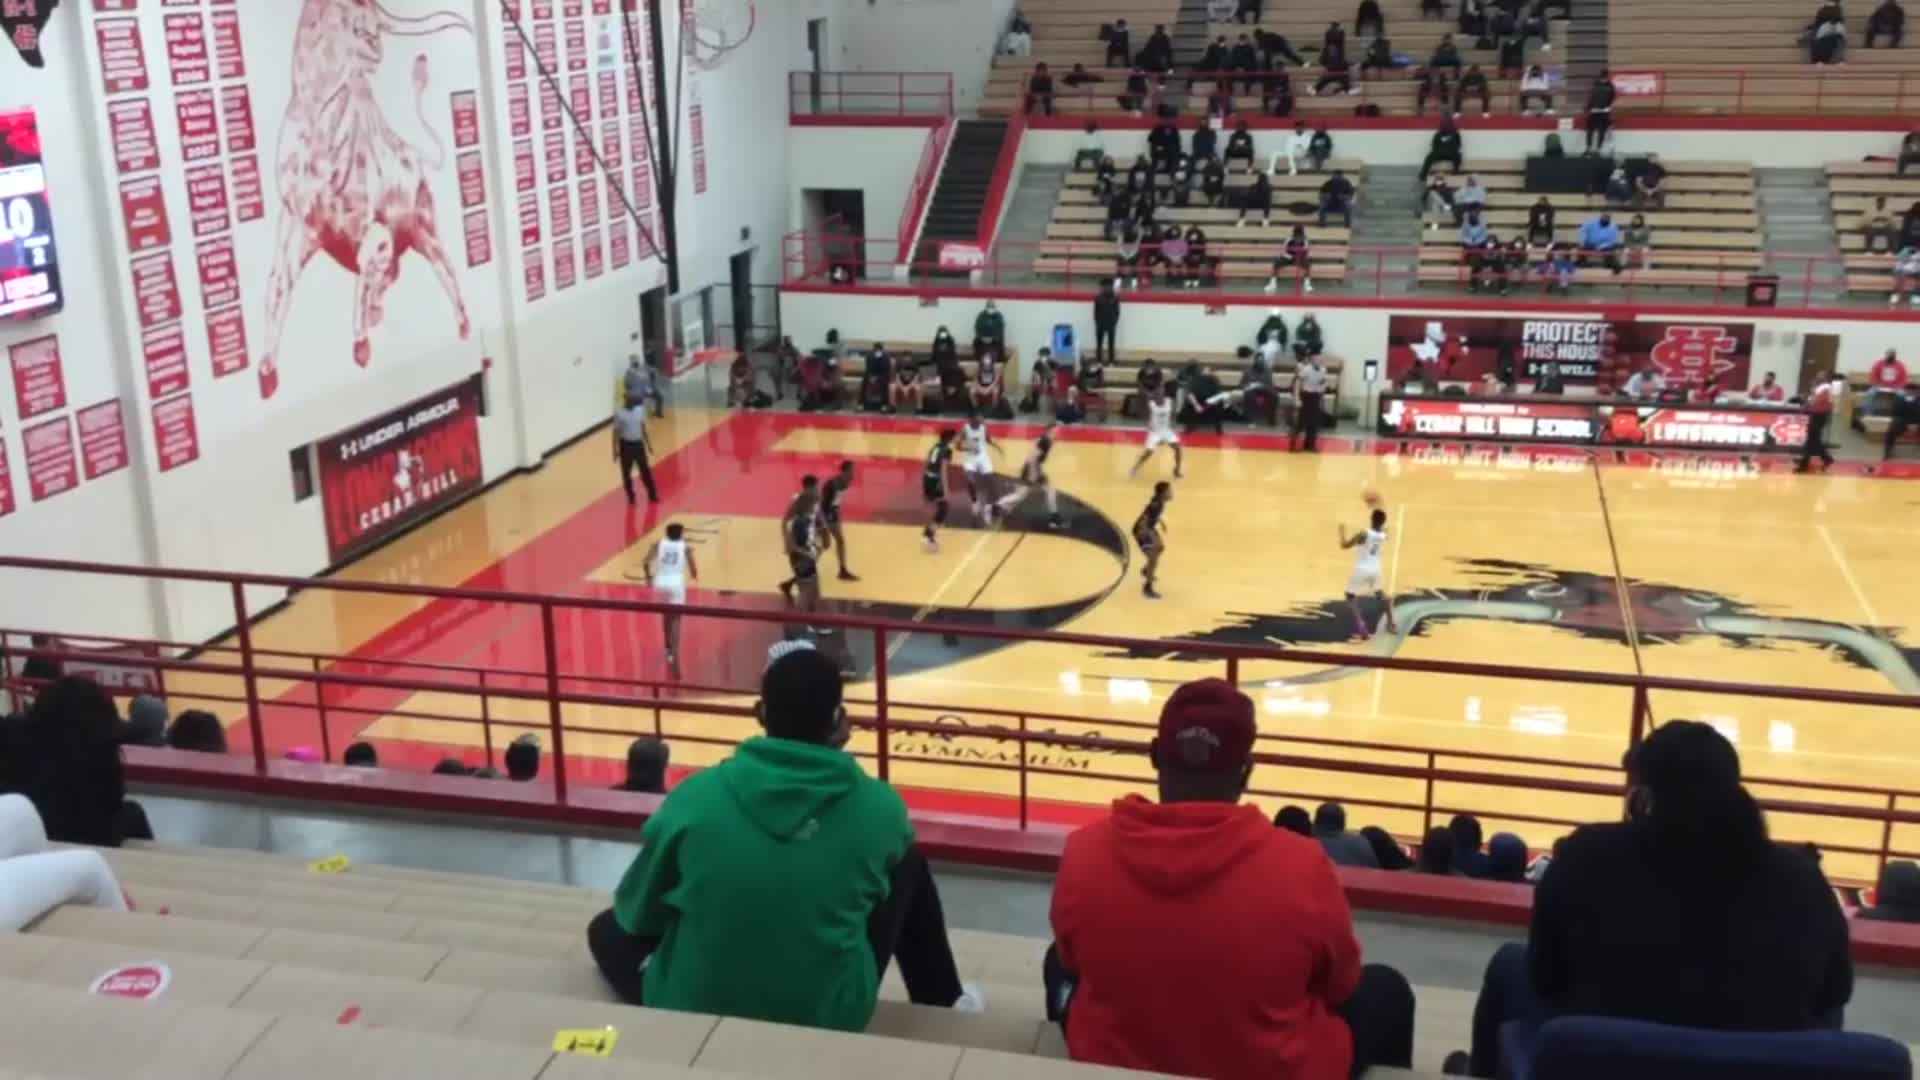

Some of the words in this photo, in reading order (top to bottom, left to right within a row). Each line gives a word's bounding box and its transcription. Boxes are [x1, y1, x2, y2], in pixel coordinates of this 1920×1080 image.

[1522, 320, 1611, 343] PROTECT
[1522, 343, 1555, 359] THIS
[1557, 344, 1606, 361] HOUS
[359, 421, 405, 450] UNDER
[407, 398, 460, 430] ARMOUR
[1537, 418, 1593, 438] SCHOOL
[1653, 423, 1766, 445] LONGHORNS
[360, 491, 417, 529] CEDAR
[421, 468, 459, 499] HILL
